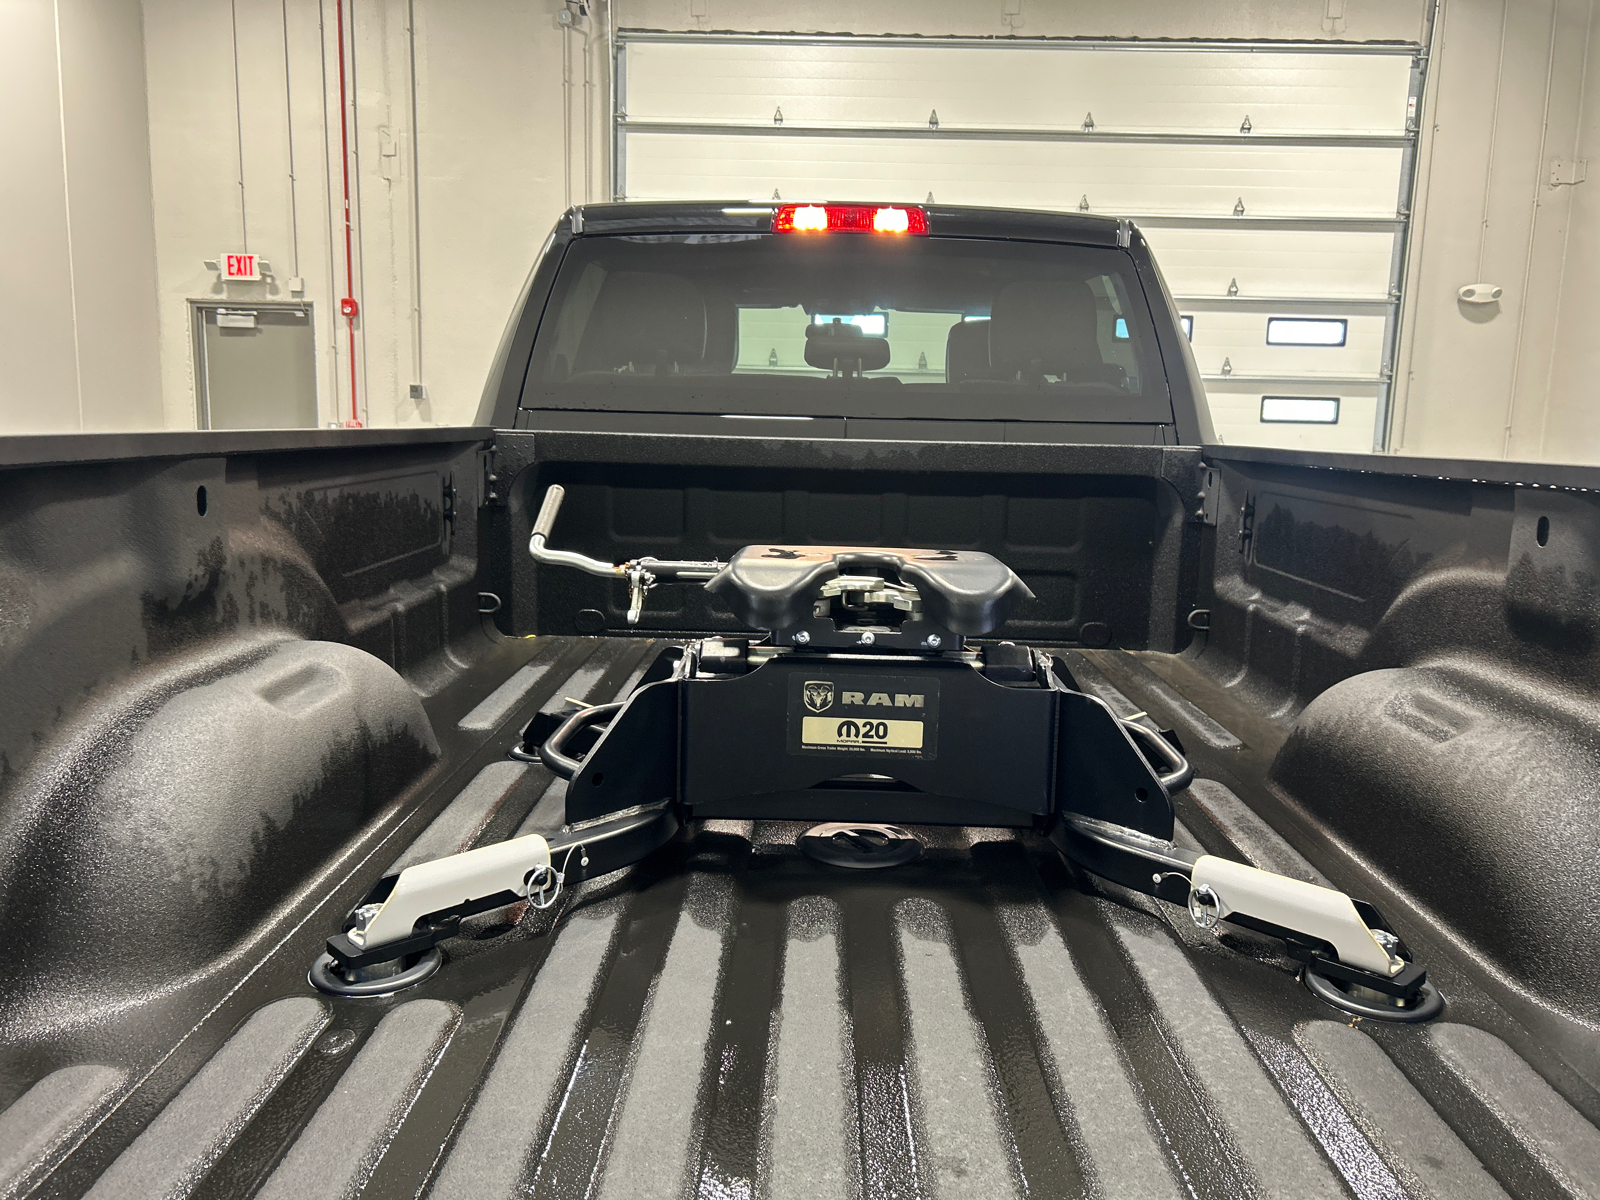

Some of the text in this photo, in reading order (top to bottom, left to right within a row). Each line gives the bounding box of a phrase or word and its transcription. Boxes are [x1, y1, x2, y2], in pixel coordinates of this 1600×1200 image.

[227, 255, 254, 276] EXIT
[841, 691, 924, 708] RAM
[862, 721, 888, 740] 20
